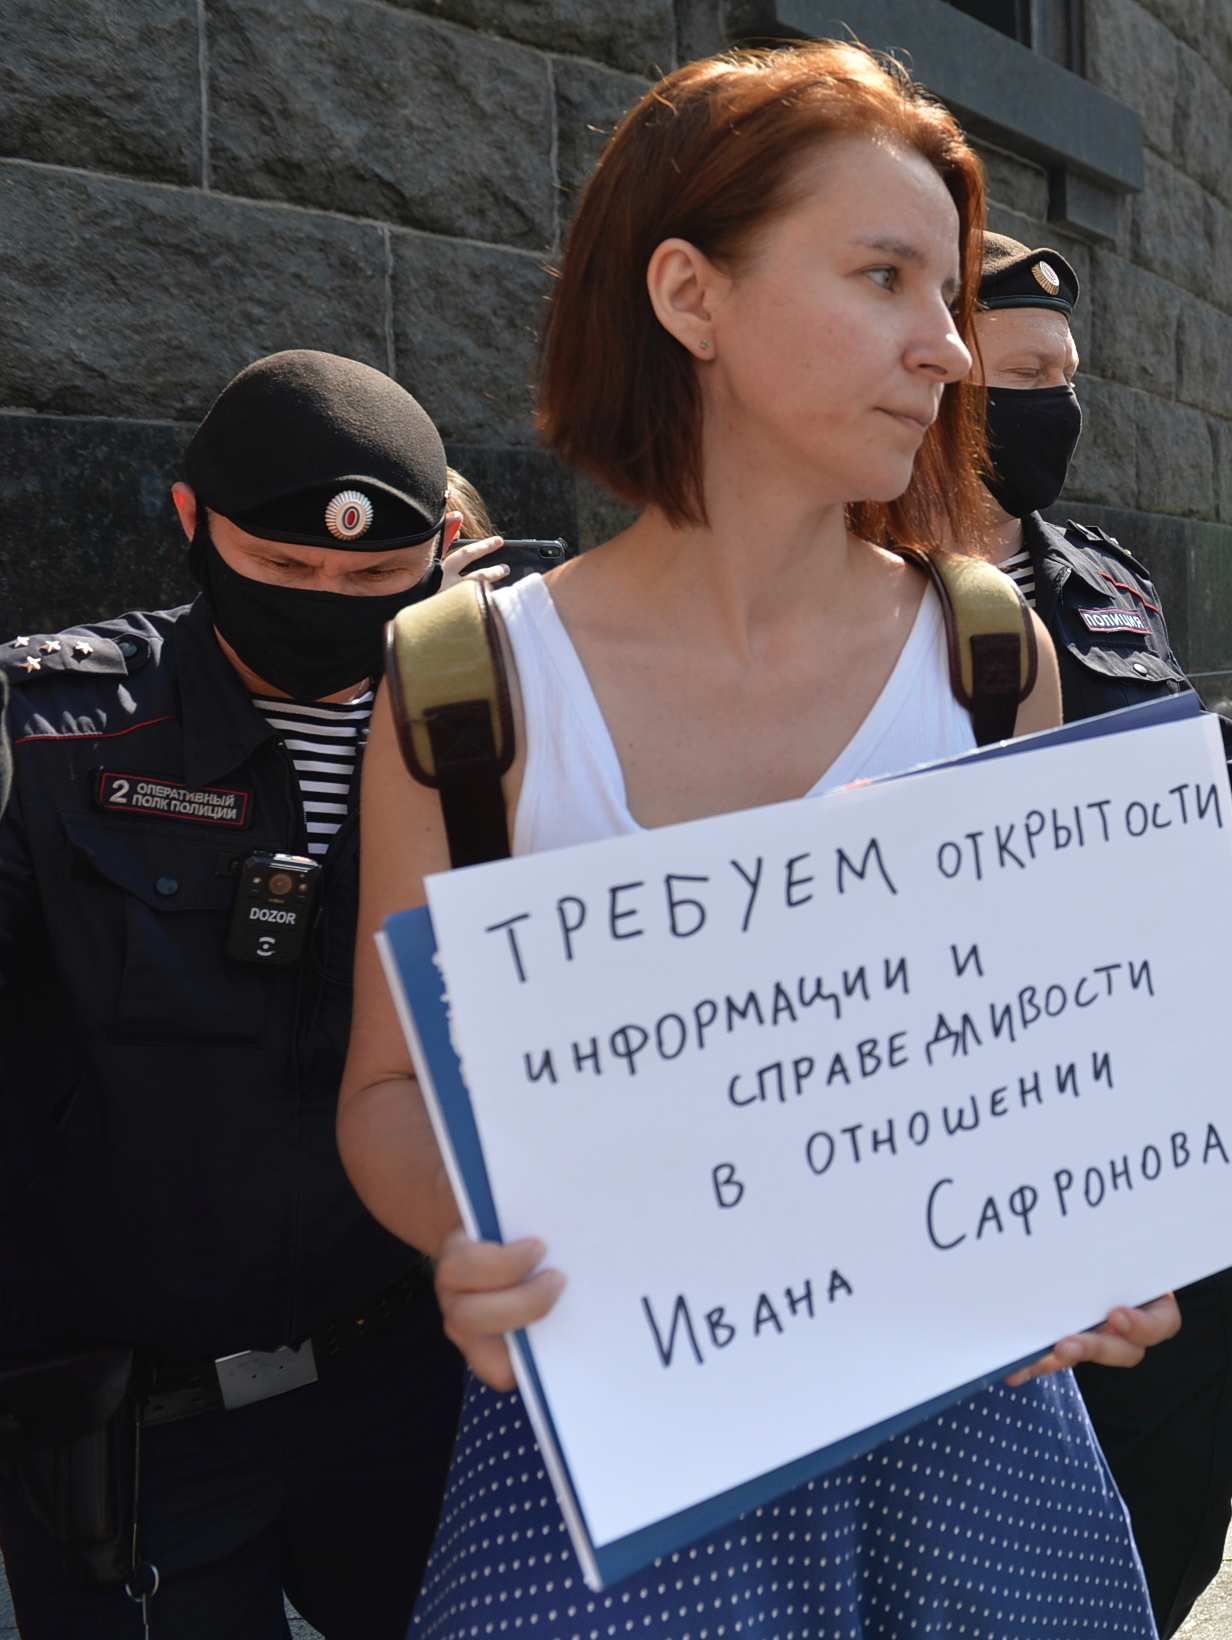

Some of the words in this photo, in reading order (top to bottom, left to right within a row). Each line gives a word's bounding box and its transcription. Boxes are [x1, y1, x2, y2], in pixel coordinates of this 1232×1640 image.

[1083, 613, 1145, 629] ПОЛИЦИЯ
[109, 779, 130, 803] 2
[136, 782, 236, 806] ОПЕРАТИВНЫЙ
[132, 794, 169, 811] ПОЛК
[170, 800, 237, 820] ПОЛИЦИИ
[249, 907, 296, 925] DOZOR
[486, 837, 897, 983] ТРЕБУЕМ
[937, 783, 1224, 881] ОТКРЫТОСТИ
[524, 957, 910, 1085] ИНФОРМАЦИИ
[950, 944, 985, 978] И
[727, 959, 1155, 1108] СПРАВЕДЛИВОСТИ
[712, 1163, 744, 1208] В
[806, 1052, 1114, 1176] ОТНОШЕНИИ
